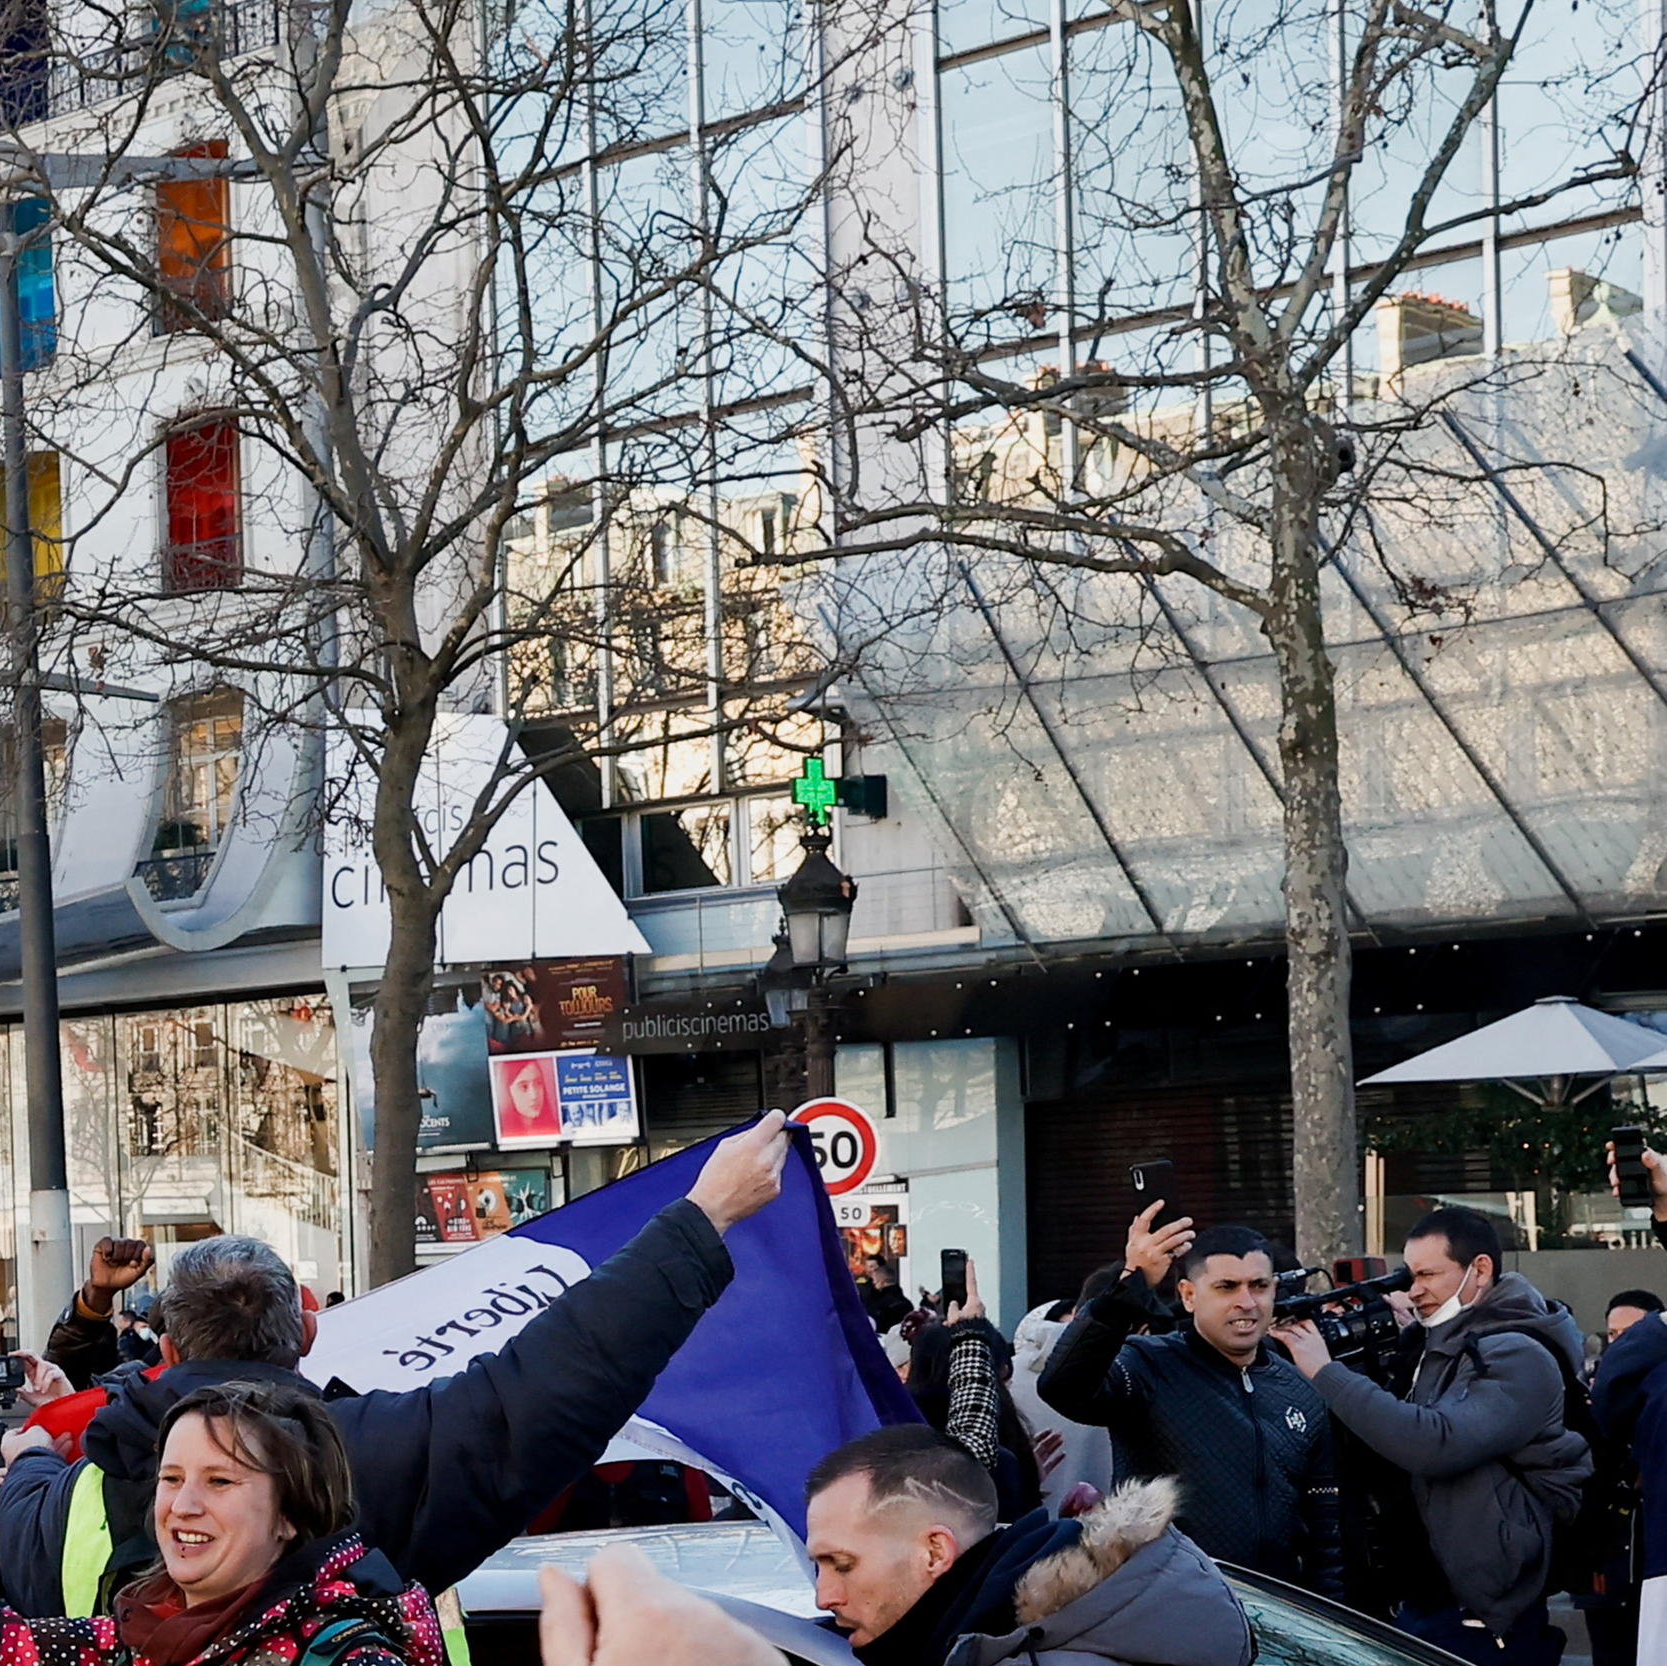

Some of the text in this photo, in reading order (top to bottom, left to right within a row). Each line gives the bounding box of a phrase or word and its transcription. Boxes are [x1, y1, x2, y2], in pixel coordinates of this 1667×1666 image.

[331, 840, 559, 909] cimas
[571, 984, 597, 1000] POUR
[622, 1012, 770, 1042] publiciscinemas
[811, 1131, 858, 1169] 50
[840, 1207, 862, 1220] 50
